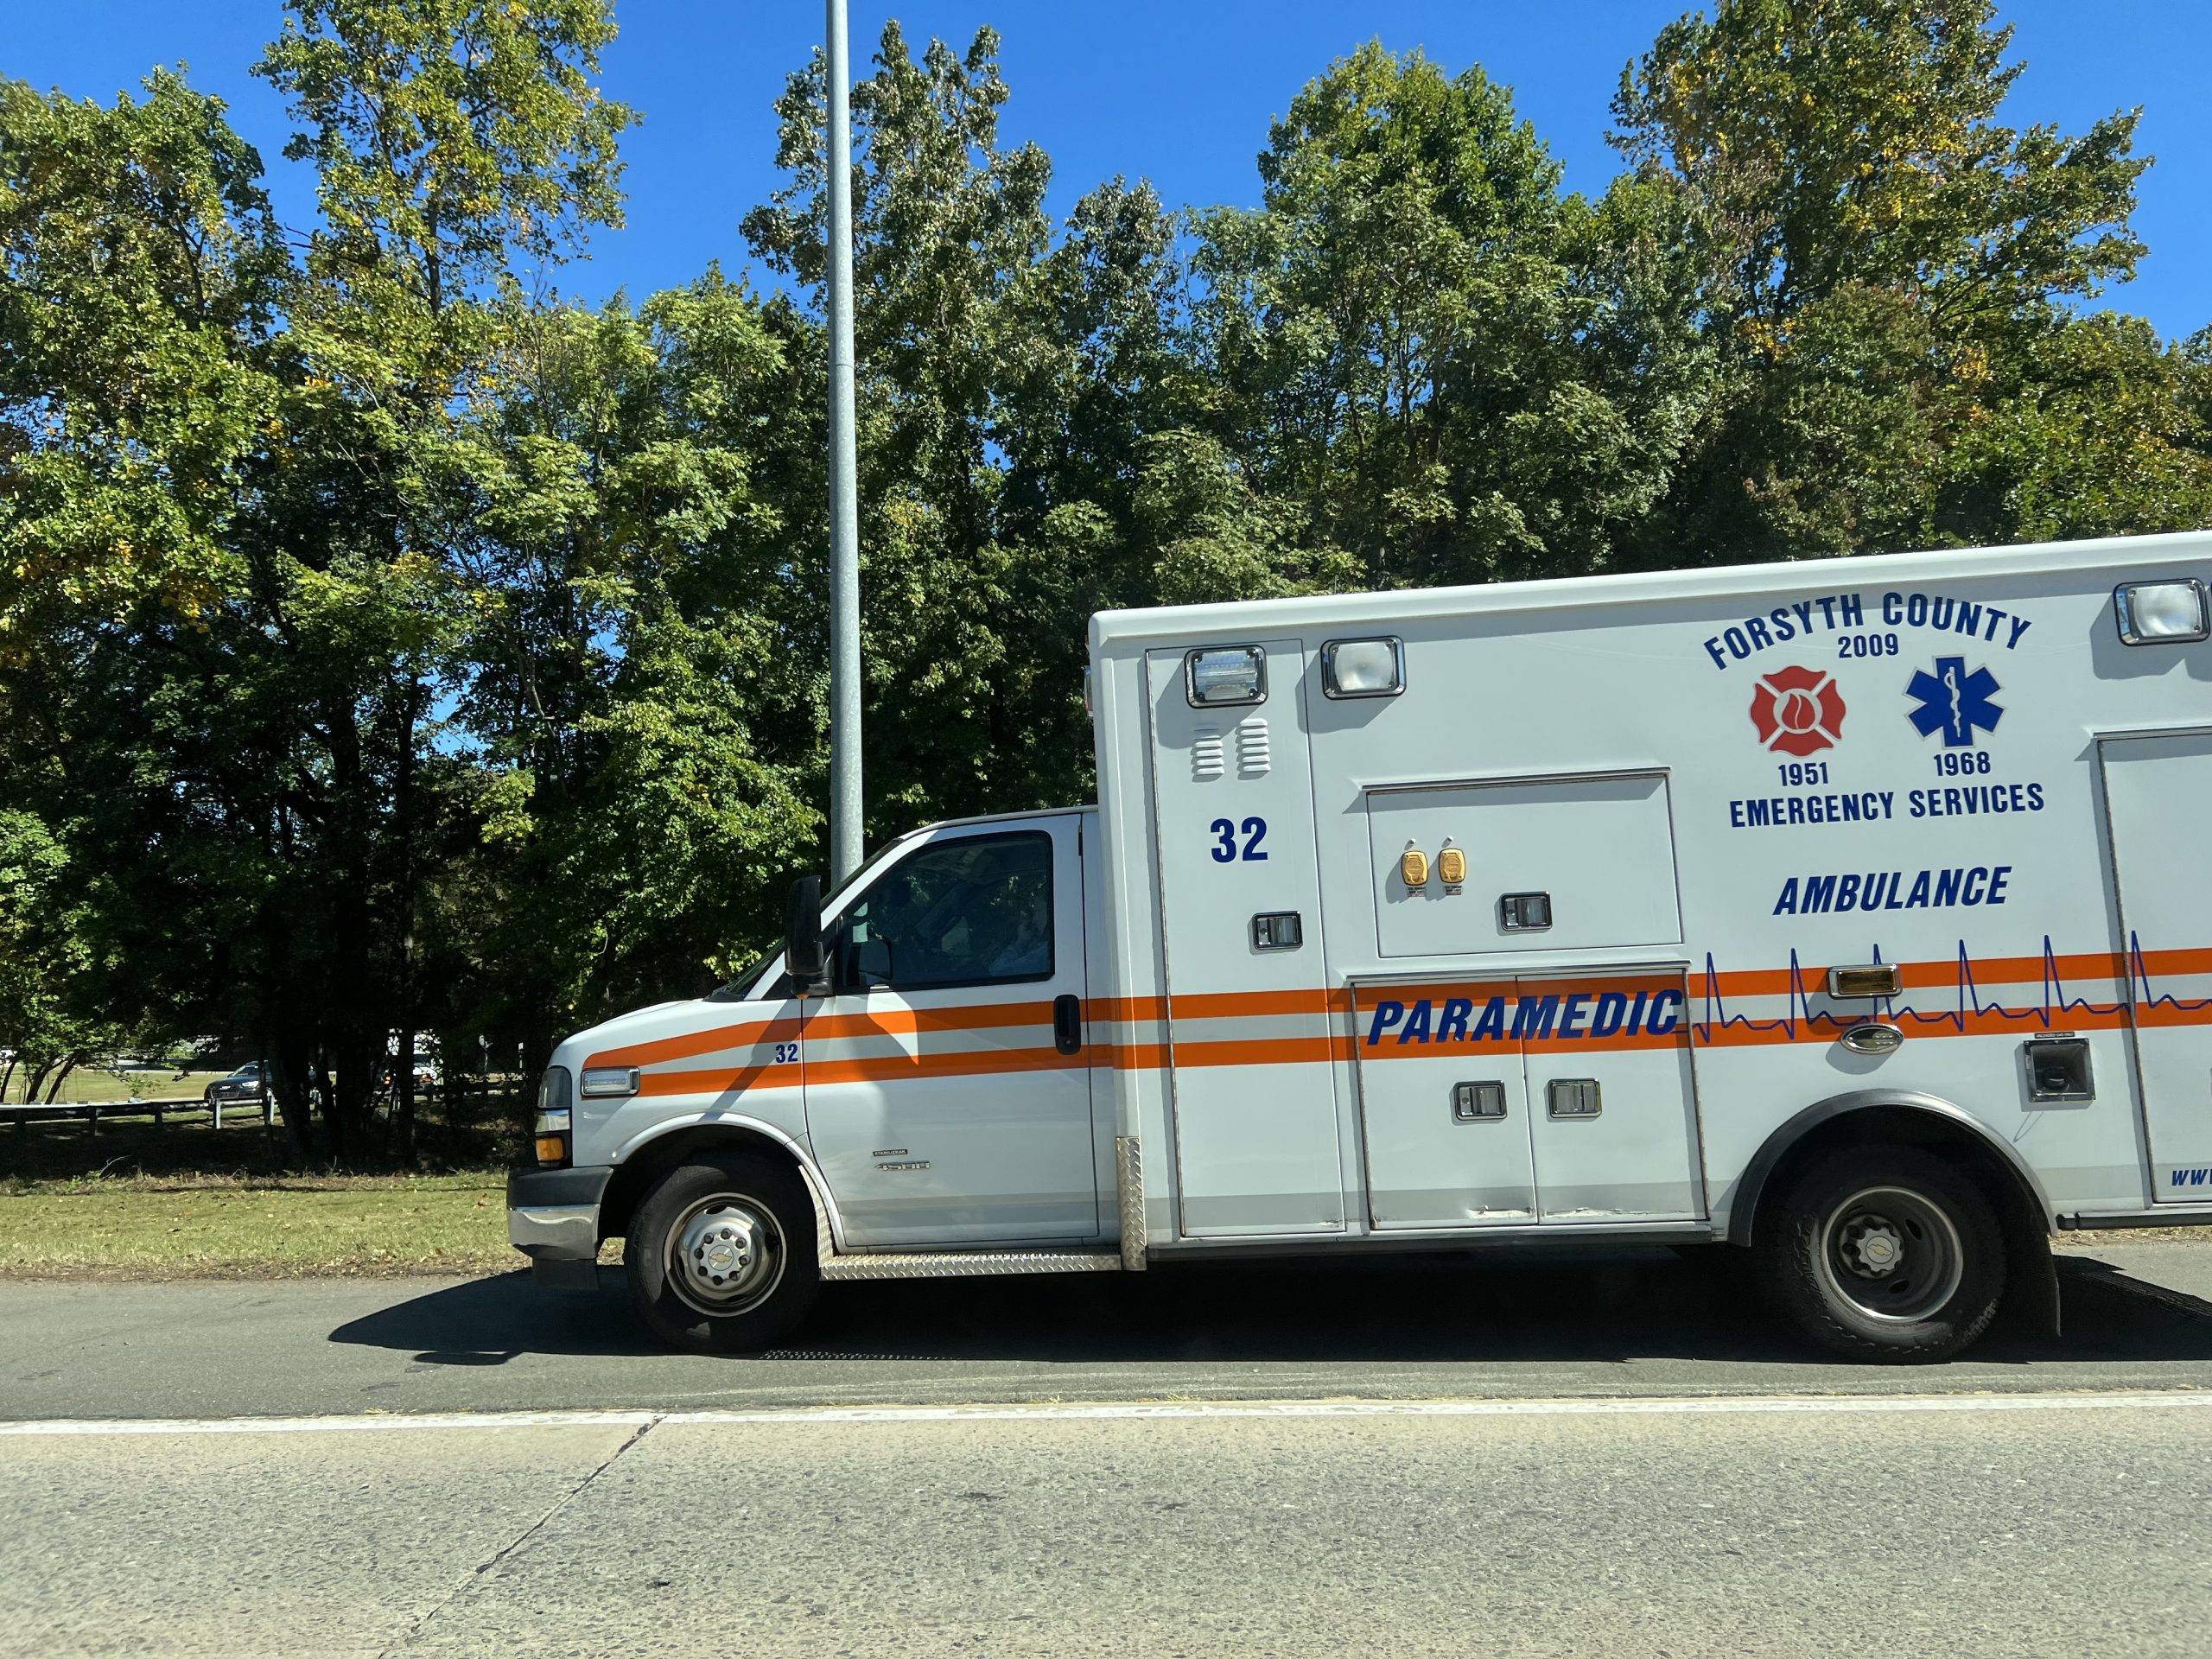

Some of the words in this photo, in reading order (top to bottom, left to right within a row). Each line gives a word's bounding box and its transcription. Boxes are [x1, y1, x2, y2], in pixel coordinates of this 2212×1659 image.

[1703, 593, 1864, 671] FORSYTH
[1882, 592, 2032, 651] COUNTY
[1838, 632, 1899, 658] 2009
[1778, 761, 1828, 786] 1951
[1933, 751, 1991, 777] 1968
[1730, 791, 1894, 828] EMERGENCY
[1910, 783, 2044, 818] SERVICES
[1210, 817, 1268, 863] 32
[1772, 866, 2012, 916] AMBULANCE
[1367, 988, 1683, 1046] PARAMEDIC
[775, 1043, 798, 1064] 32
[2171, 1168, 2212, 1186] WW
